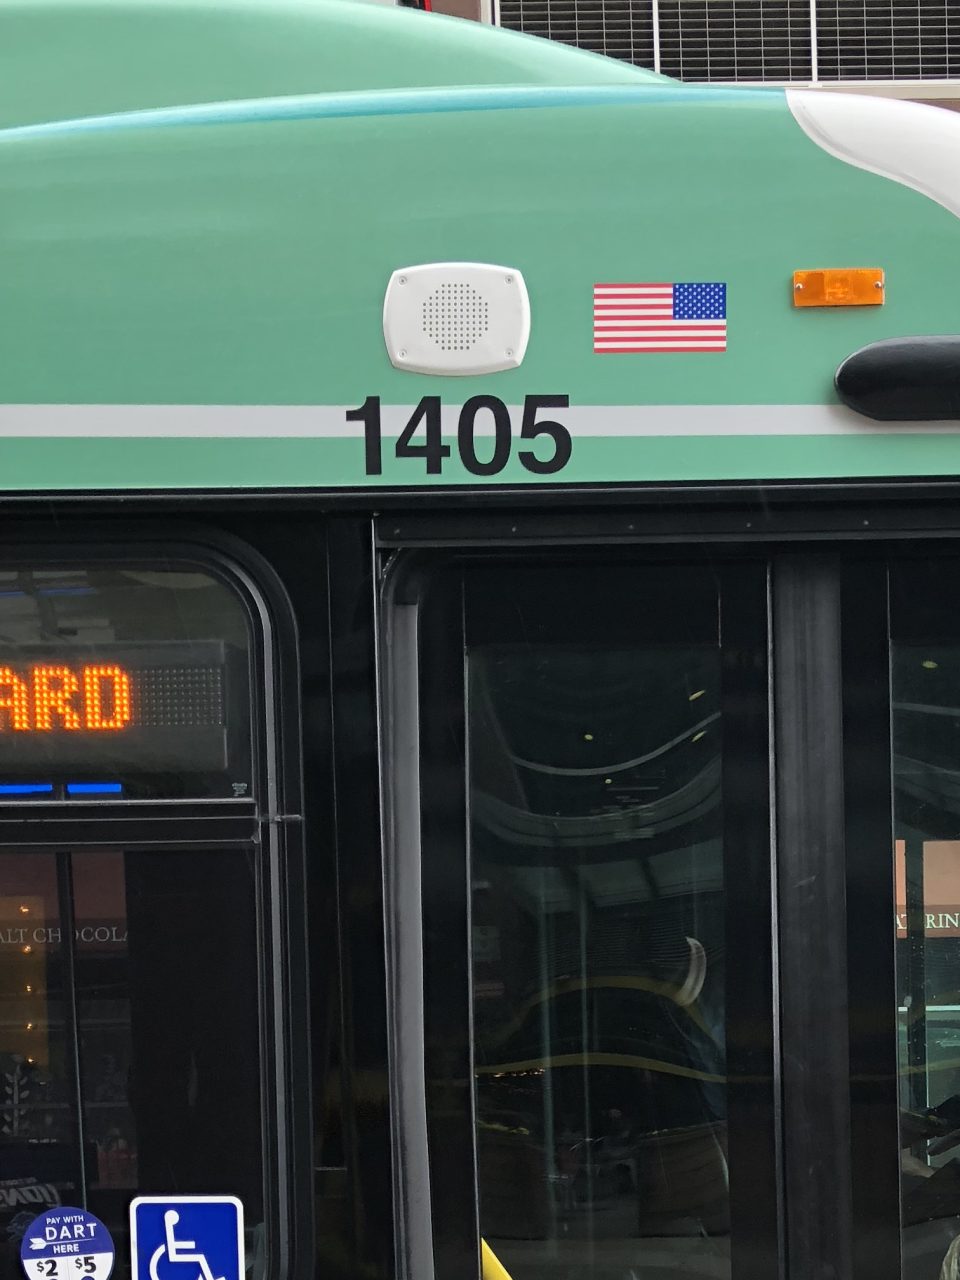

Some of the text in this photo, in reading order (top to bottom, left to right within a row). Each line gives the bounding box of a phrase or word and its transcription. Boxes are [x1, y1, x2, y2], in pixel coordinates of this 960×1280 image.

[346, 394, 573, 476] 1405
[0, 663, 131, 732] ARD
[46, 1214, 85, 1226] PAY WITH
[45, 1222, 97, 1241] DART
[53, 1243, 80, 1254] HERE
[36, 1256, 97, 1277] $2 $5
